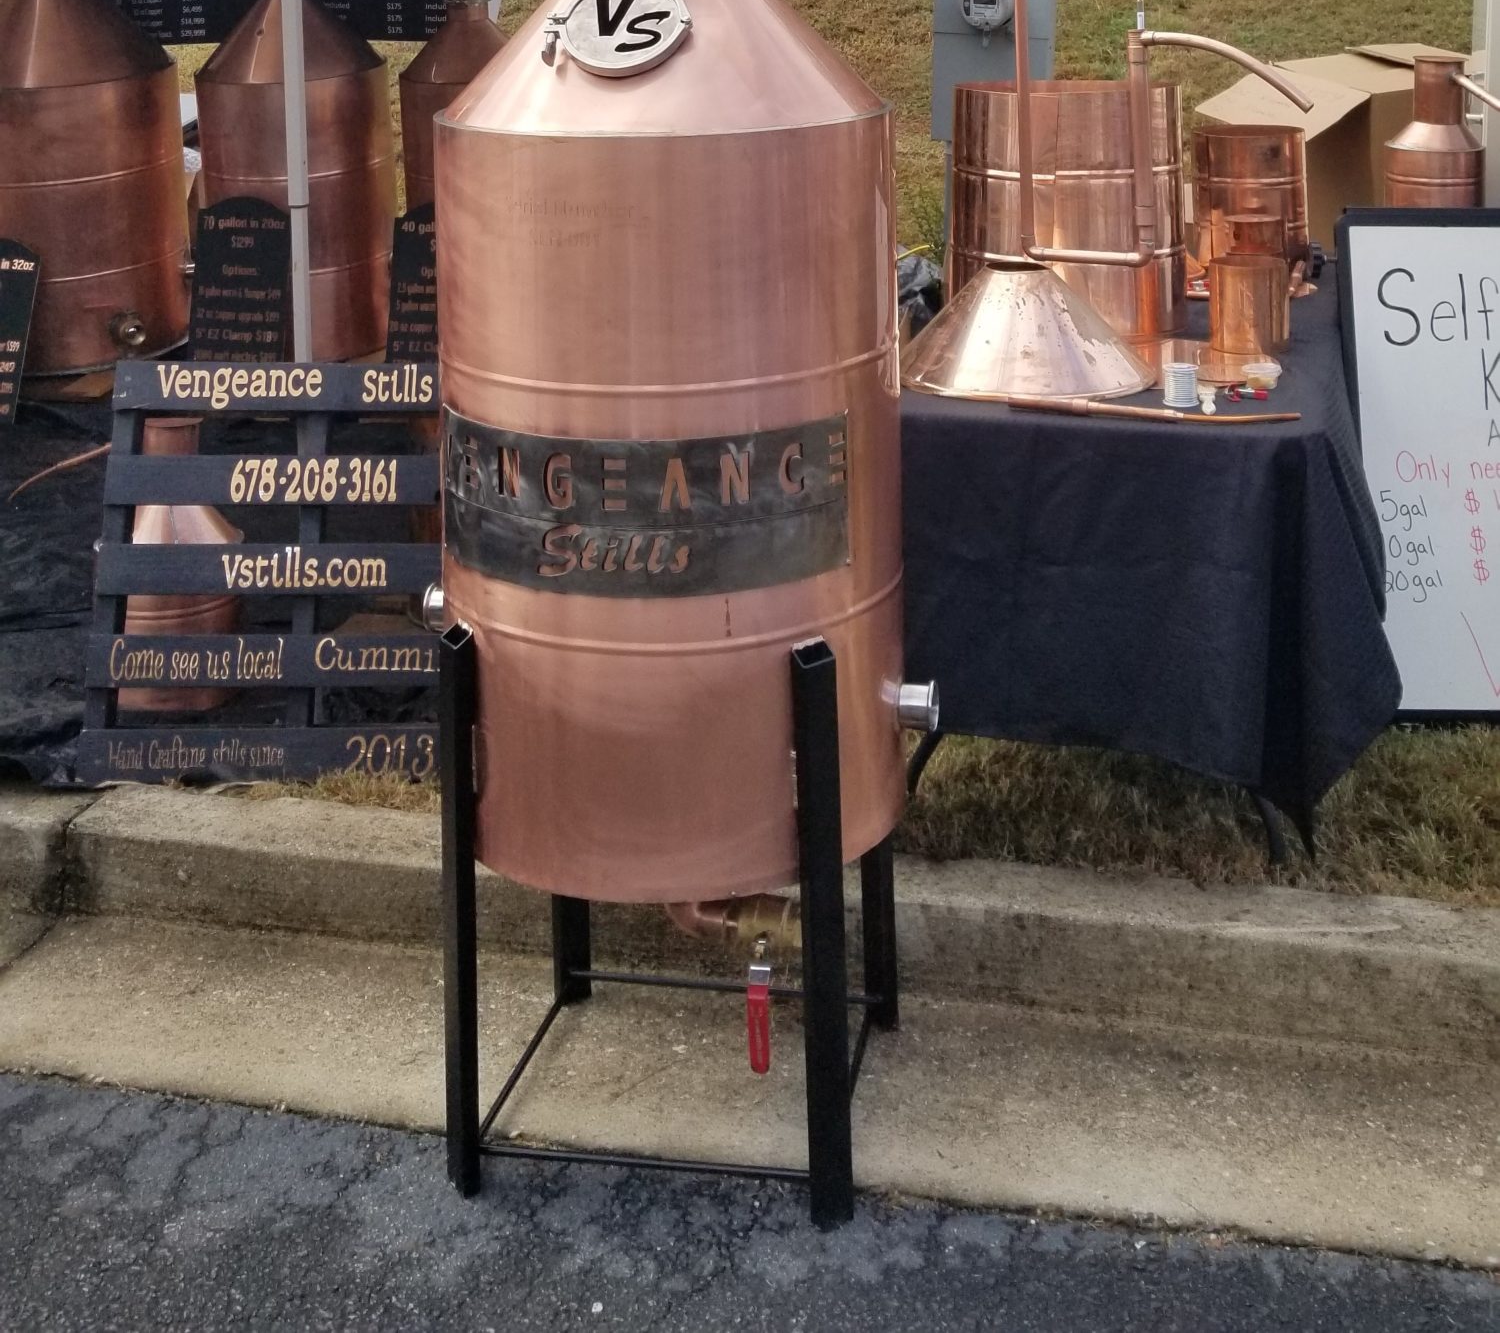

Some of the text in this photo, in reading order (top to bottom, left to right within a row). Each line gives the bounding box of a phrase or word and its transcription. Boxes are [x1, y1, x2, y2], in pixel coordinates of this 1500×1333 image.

[386, 2, 402, 10] $175
[425, 2, 447, 10] Includ
[387, 14, 402, 22] $175
[425, 14, 447, 22] Includ
[387, 26, 403, 34] $175
[203, 215, 215, 230] 70
[218, 216, 247, 230] gallon
[249, 217, 259, 228] in
[401, 221, 416, 233] 40
[1, 258, 35, 271] in 32oz
[1377, 267, 1500, 347] Self
[207, 329, 220, 339] EZ
[222, 329, 253, 343] Clamp
[408, 341, 421, 352] EZ
[157, 364, 434, 410] Vengeance Stills
[229, 457, 398, 503] 678-208-3161
[447, 431, 847, 514] ENGEANCE
[1395, 450, 1451, 489] Only
[222, 546, 387, 589] Vstills.com
[536, 523, 691, 577] Stills
[1389, 534, 1435, 566] 0gal
[109, 637, 441, 681] Come see us local Cummi
[107, 740, 144, 771] Hand
[212, 737, 247, 767] stills
[250, 745, 285, 768] since
[346, 733, 435, 779] 2013
